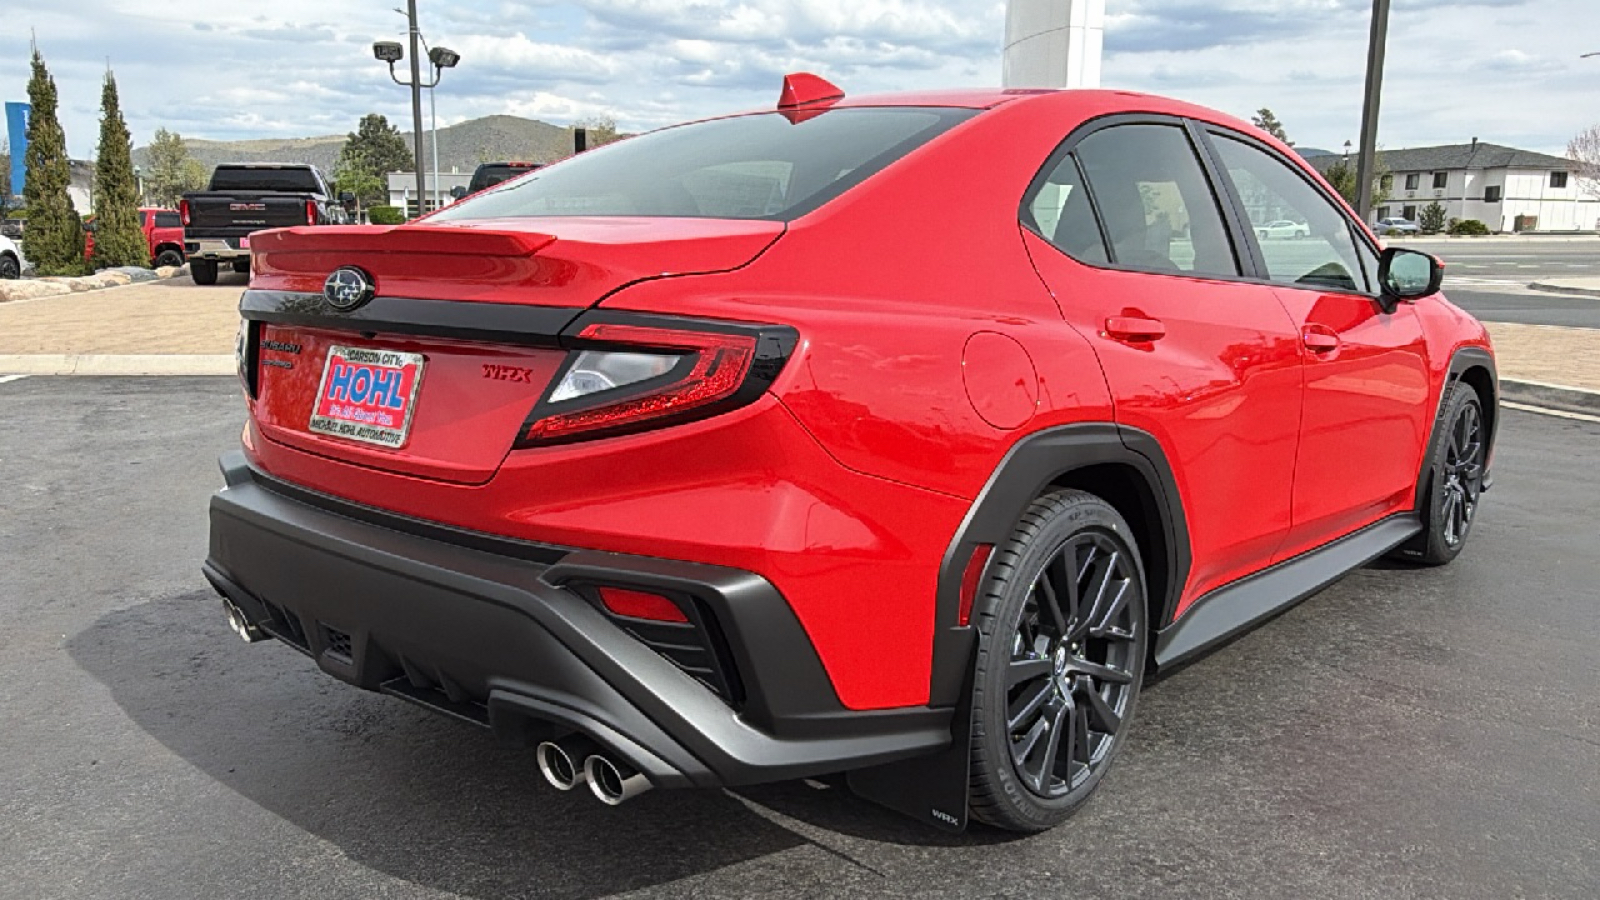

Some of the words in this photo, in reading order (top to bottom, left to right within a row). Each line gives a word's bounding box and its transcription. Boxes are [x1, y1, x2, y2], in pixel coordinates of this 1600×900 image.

[348, 349, 382, 361] CARSON
[482, 364, 533, 384] WRX
[328, 364, 404, 410] HOHL
[357, 426, 402, 445] AUTOMOTIVE
[932, 808, 959, 826] WRX
